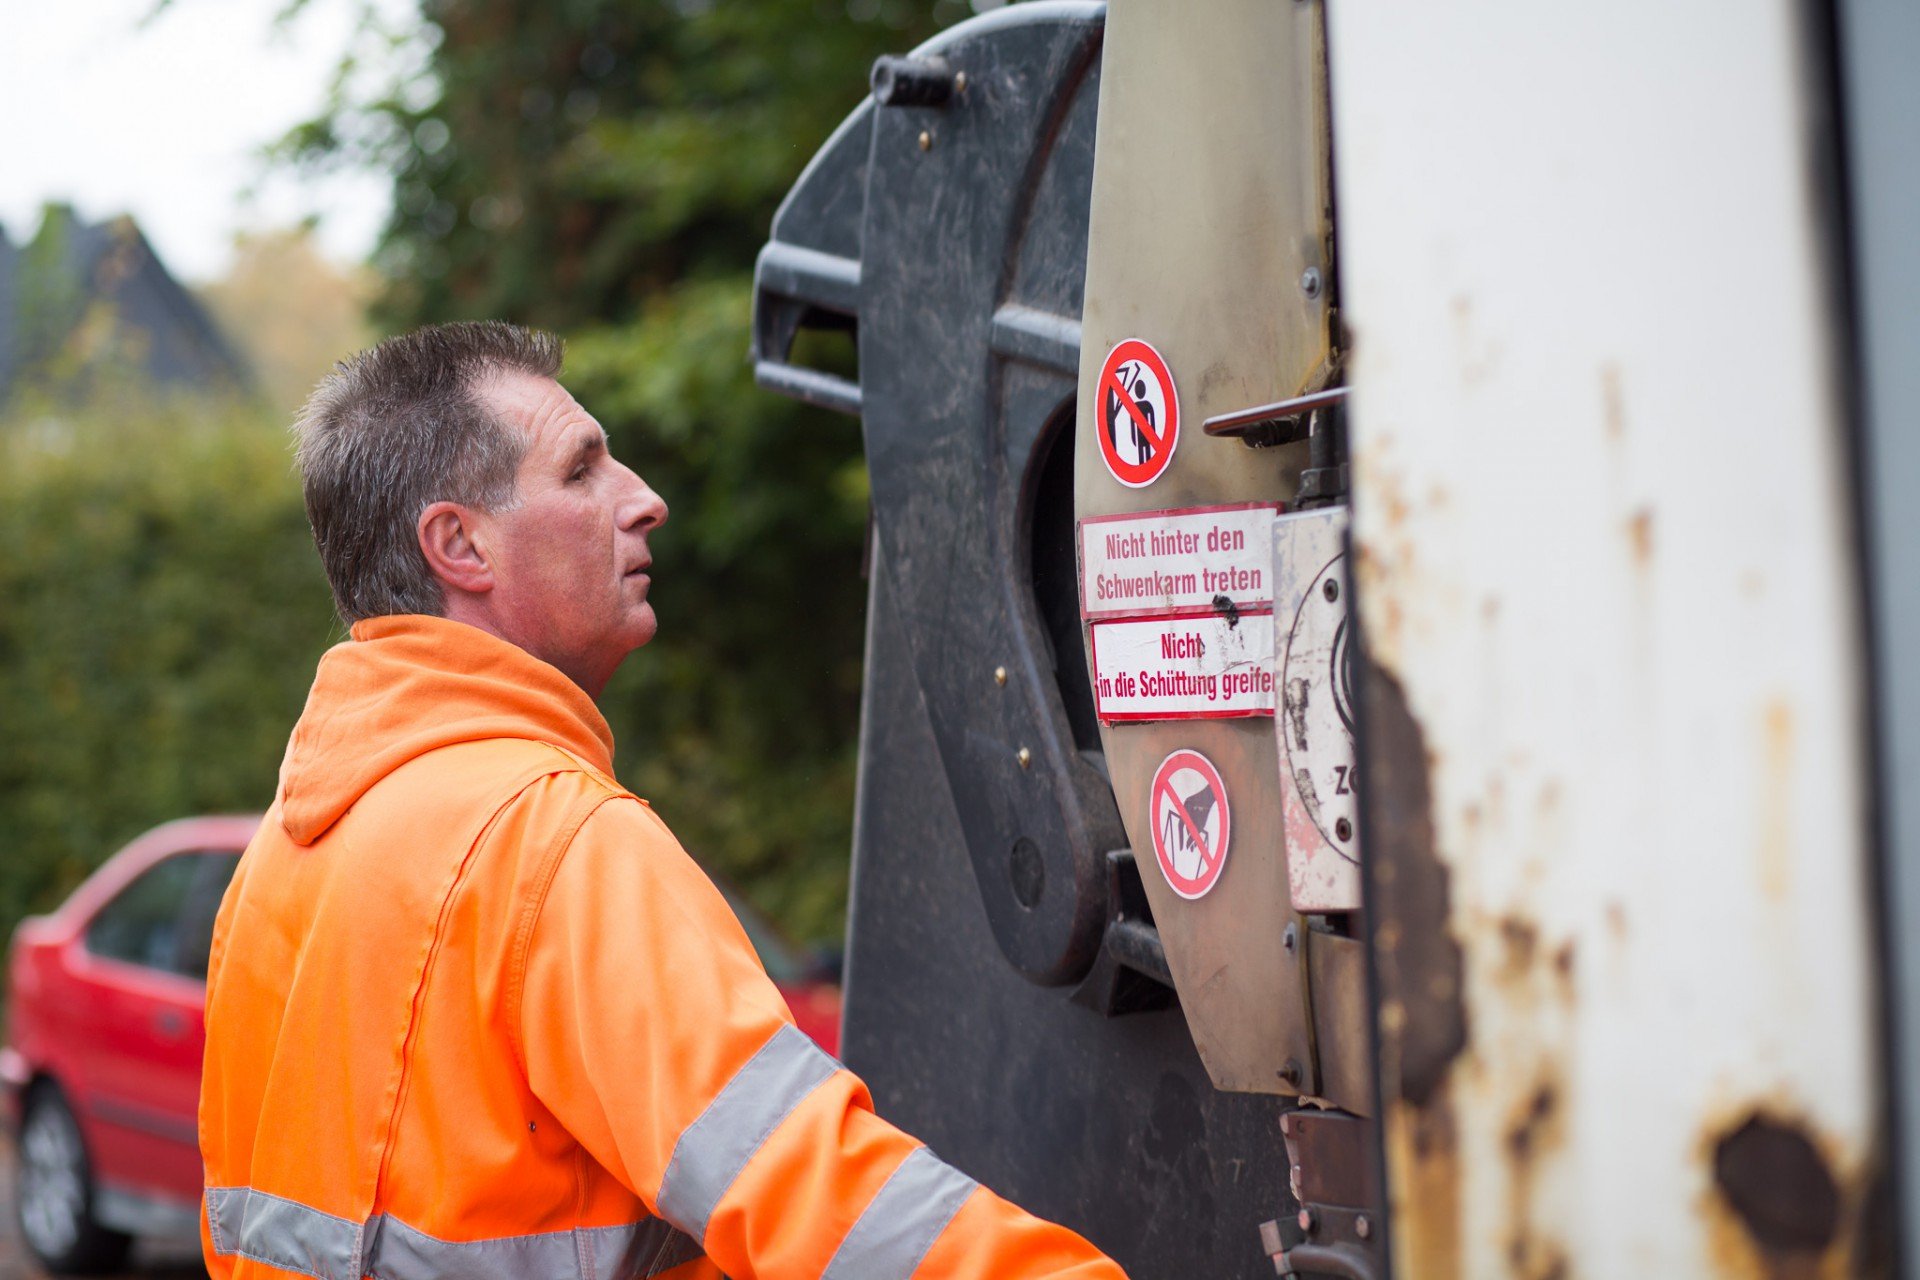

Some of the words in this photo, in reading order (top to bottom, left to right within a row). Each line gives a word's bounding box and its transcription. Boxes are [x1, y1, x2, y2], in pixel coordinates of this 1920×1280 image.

[1105, 532, 1146, 560] Nicht
[1150, 529, 1200, 556] hinter
[1207, 526, 1244, 552] den
[1096, 570, 1197, 600] Schwenkarm
[1203, 566, 1262, 594] treten
[1161, 632, 1202, 659] Nicht
[1099, 673, 1112, 698] in
[1115, 671, 1136, 698] die
[1139, 670, 1217, 701] Schüttung
